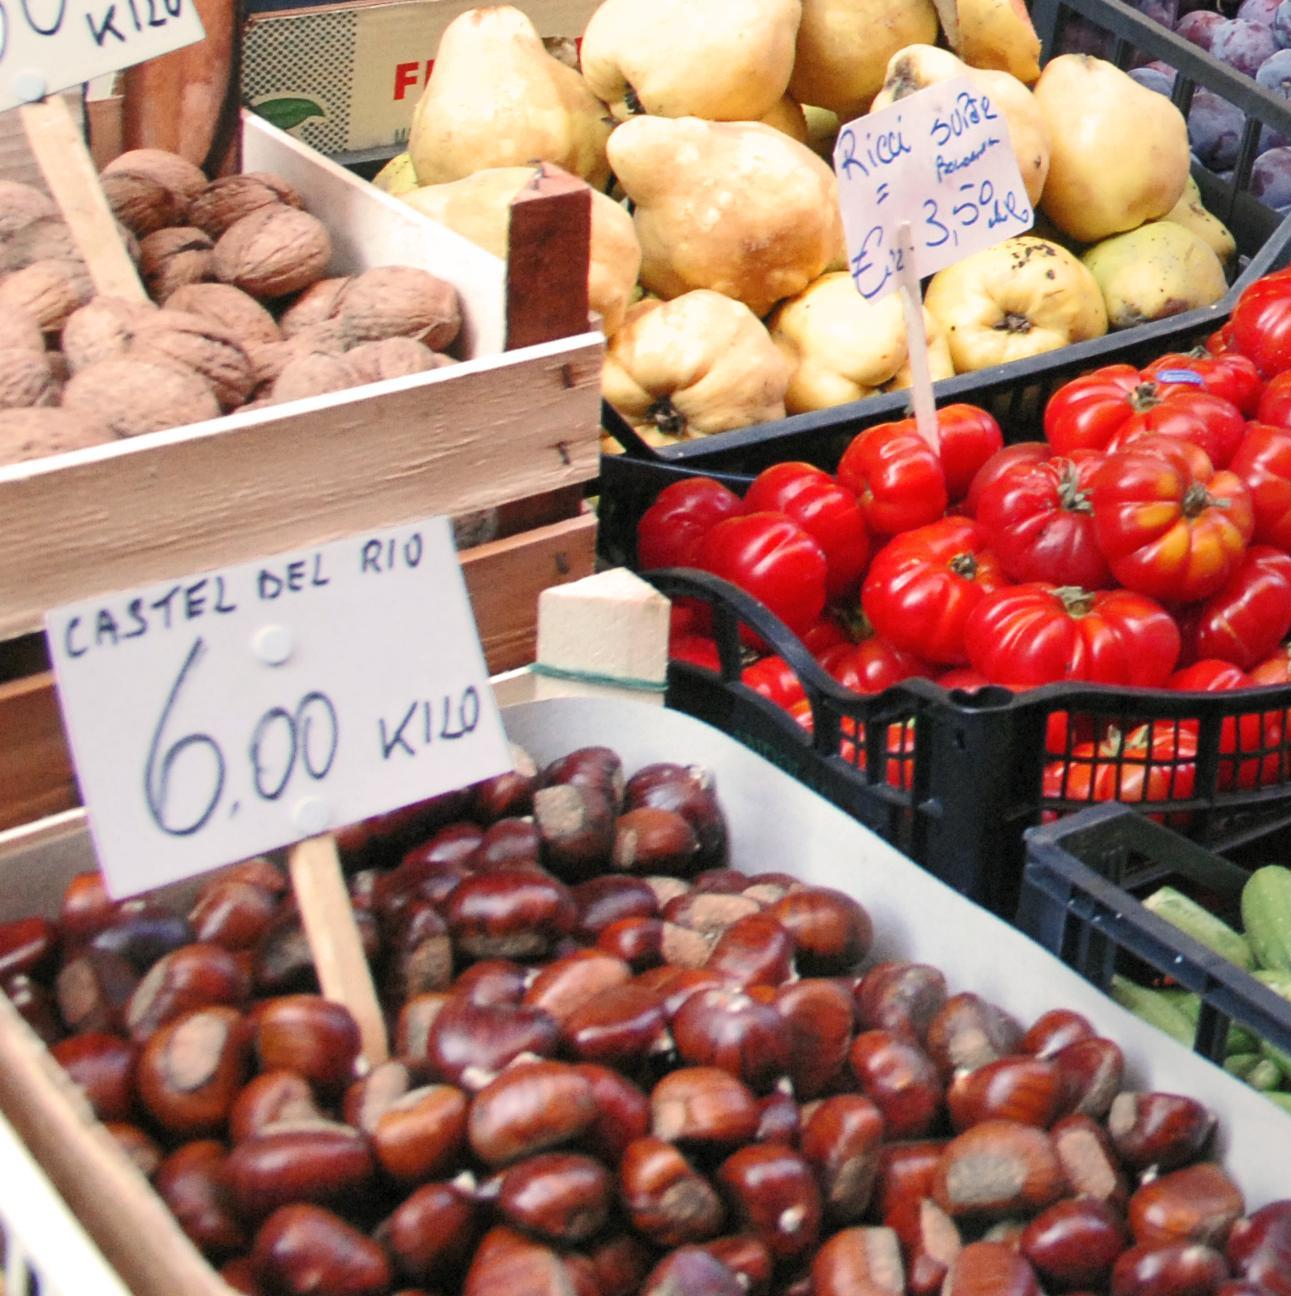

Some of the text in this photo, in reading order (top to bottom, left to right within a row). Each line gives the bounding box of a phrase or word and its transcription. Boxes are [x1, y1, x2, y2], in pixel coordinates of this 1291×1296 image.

[64, 531, 425, 659] CASTEL DEL RIO
[378, 685, 480, 762] KILO
